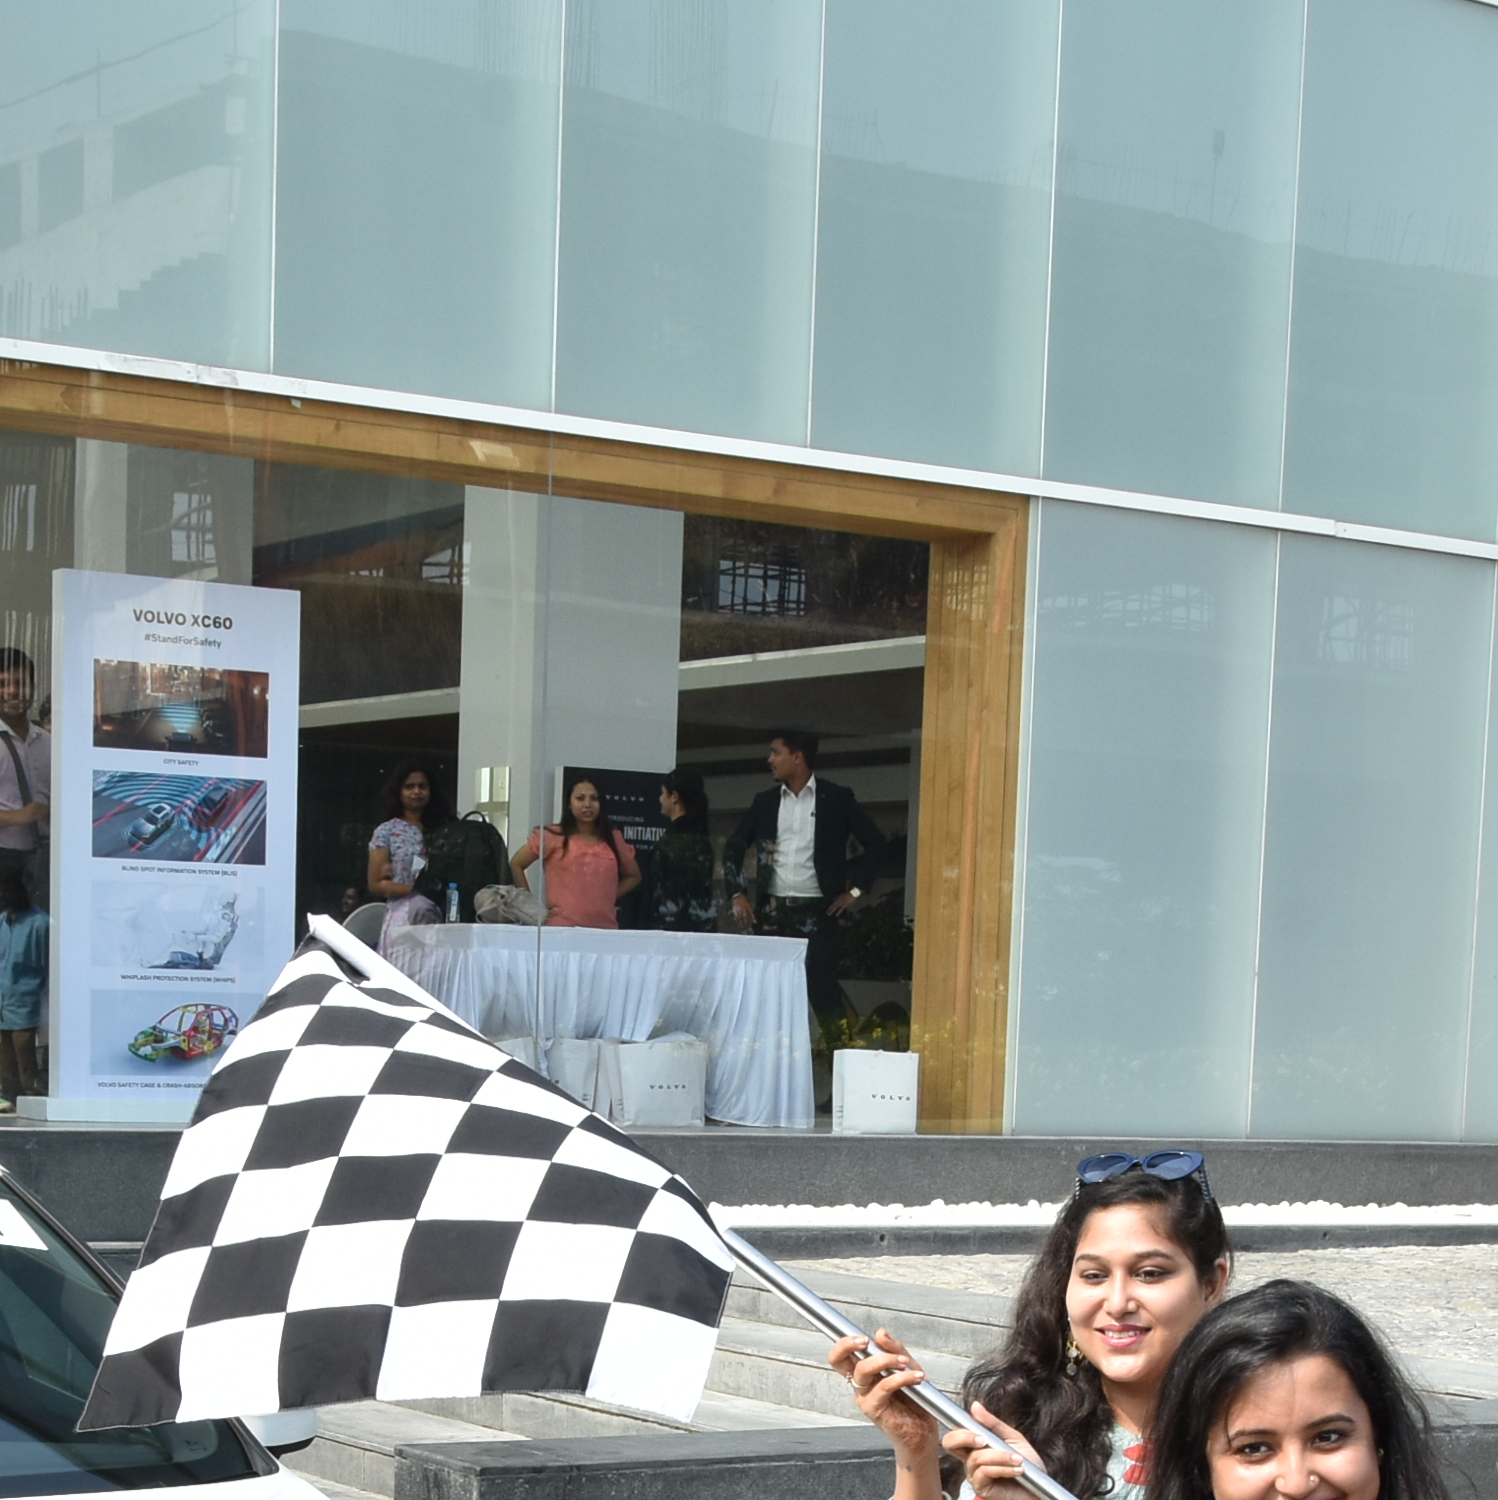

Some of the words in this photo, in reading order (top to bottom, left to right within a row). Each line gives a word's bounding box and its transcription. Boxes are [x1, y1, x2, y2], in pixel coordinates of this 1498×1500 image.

[133, 609, 186, 626] VOLVO
[191, 614, 233, 630] XC60
[144, 633, 222, 649] #StandForSafety
[177, 759, 199, 767] SAFETY
[605, 794, 645, 802] VOLVO
[156, 867, 197, 875] INFORMATION
[120, 974, 152, 982] WHIPLASH
[152, 975, 189, 983] PROTECTION
[871, 1093, 911, 1102] VOLVO
